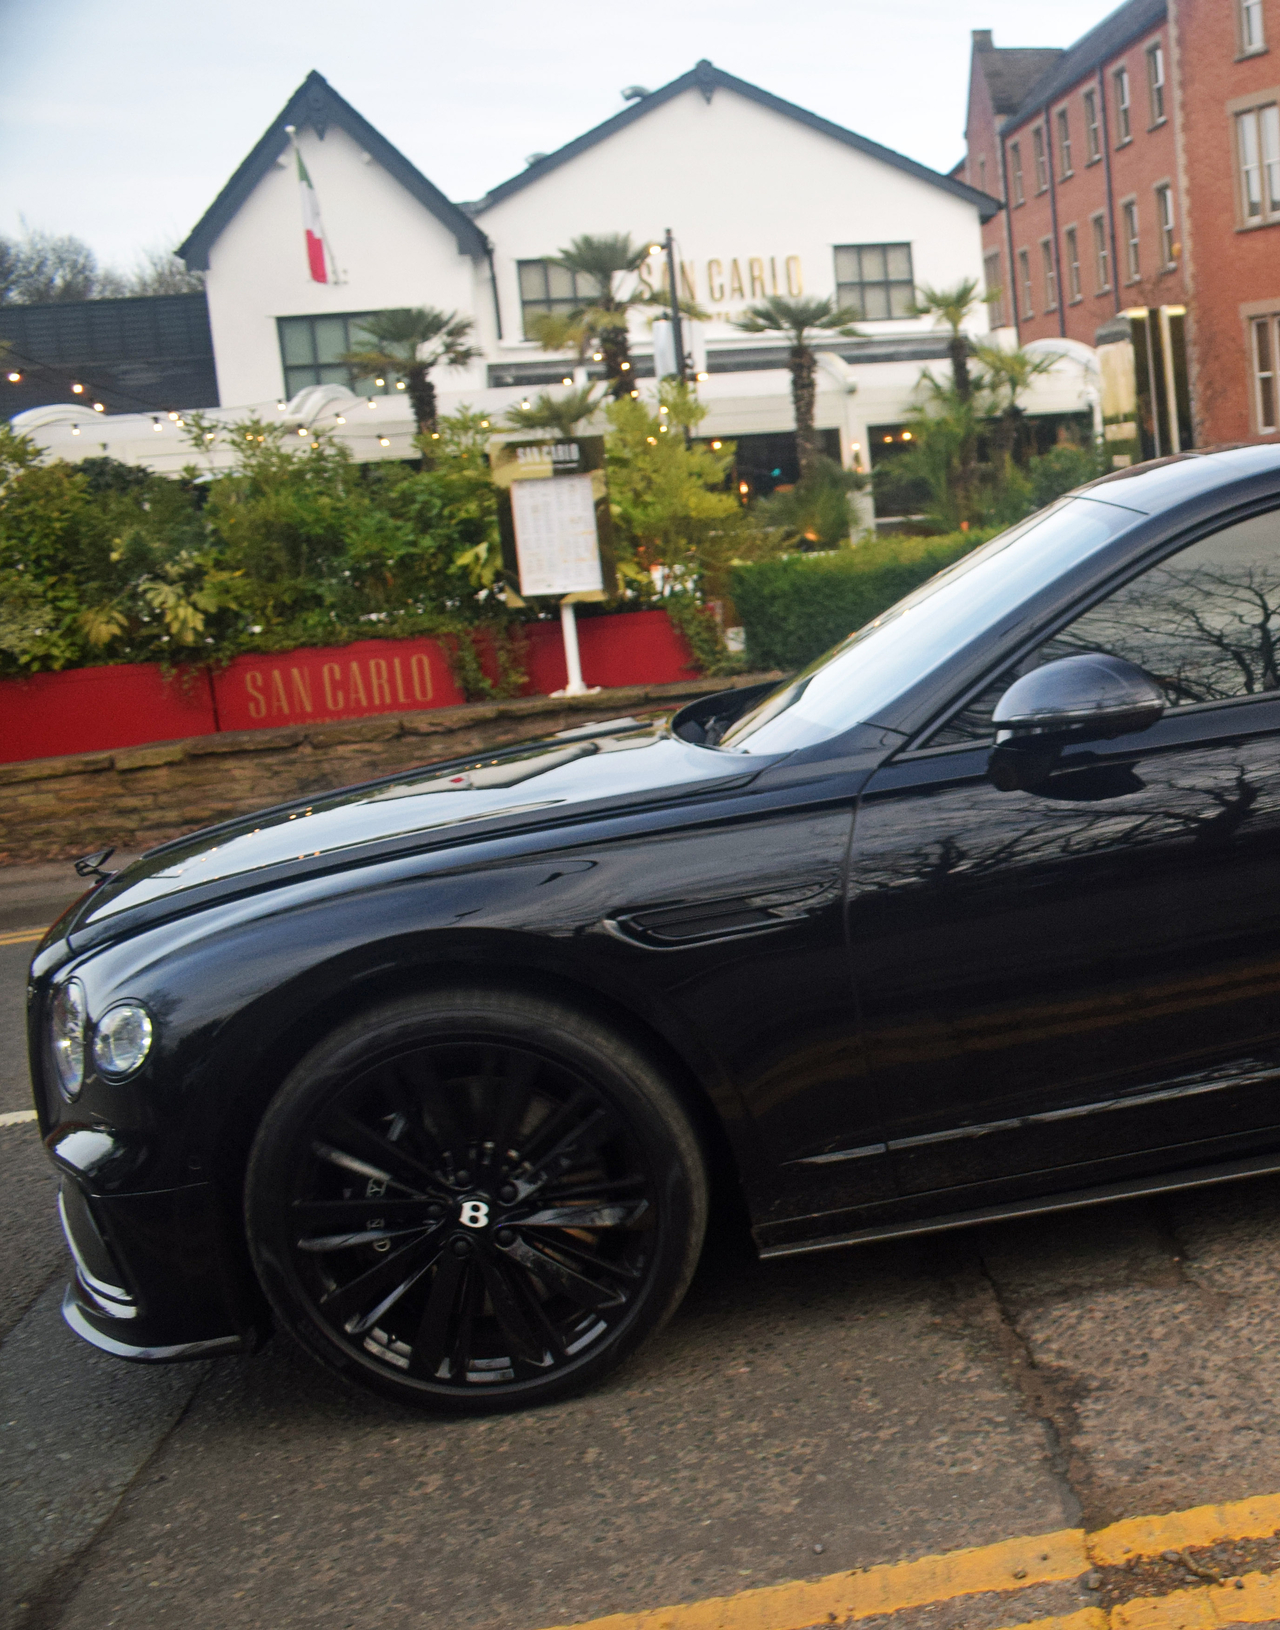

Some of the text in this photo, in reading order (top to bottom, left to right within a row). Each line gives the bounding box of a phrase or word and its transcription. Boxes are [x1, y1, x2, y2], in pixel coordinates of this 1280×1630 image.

[706, 254, 804, 302] CARLO
[245, 653, 433, 719] SAN CARLO
[459, 1201, 489, 1228] B
